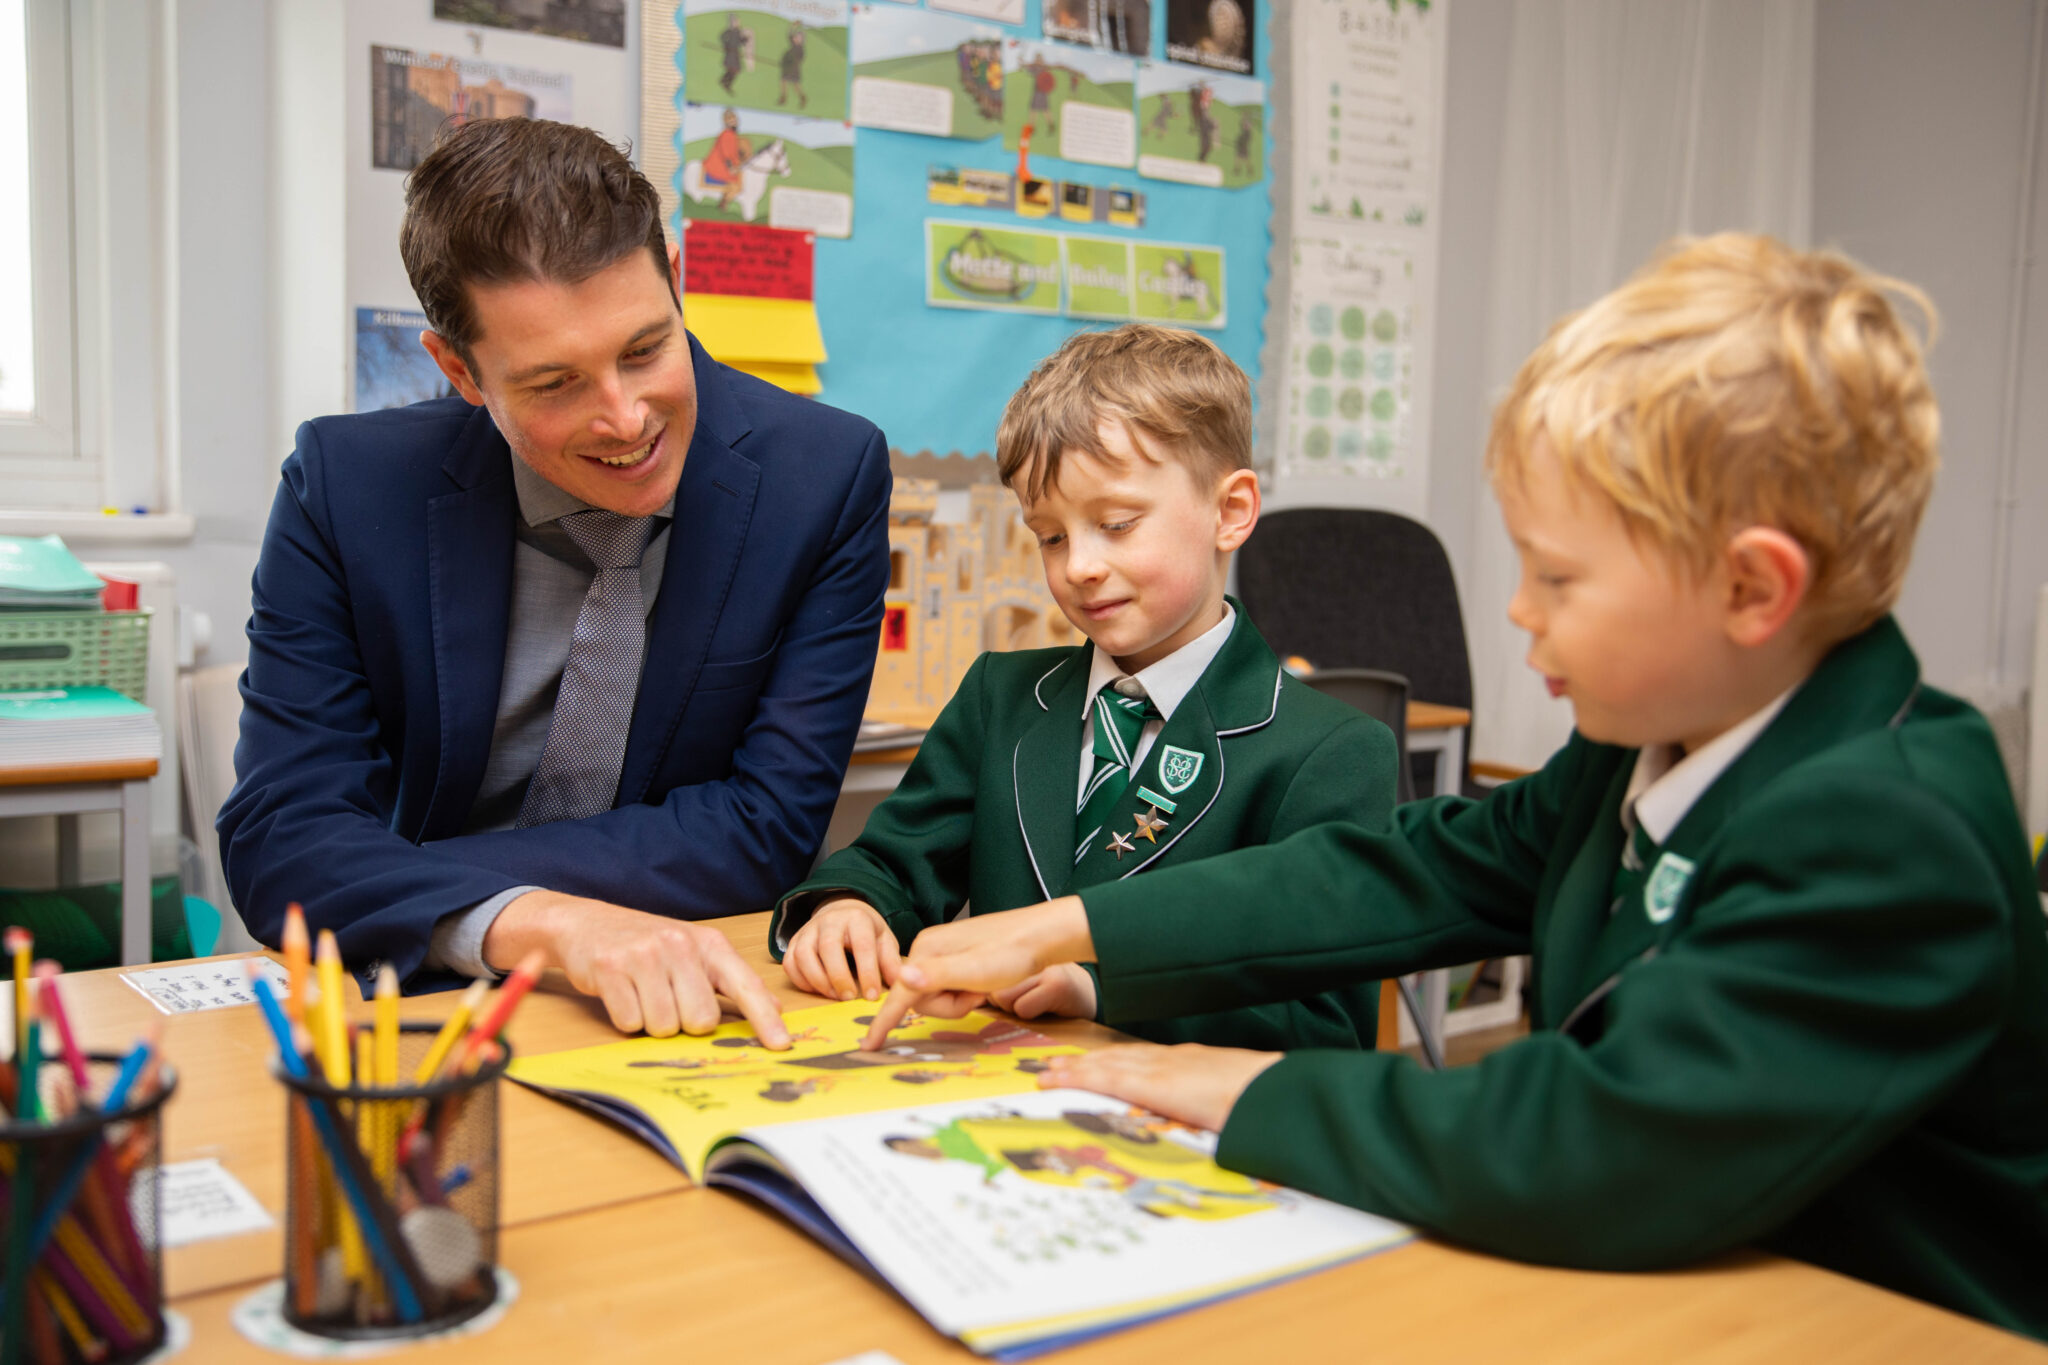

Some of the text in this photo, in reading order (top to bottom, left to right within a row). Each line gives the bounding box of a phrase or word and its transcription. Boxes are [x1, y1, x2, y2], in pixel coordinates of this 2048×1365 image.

[382, 49, 448, 70] Windsor
[507, 67, 564, 89] England
[950, 250, 1015, 280] Motte
[1018, 262, 1057, 283] and
[1070, 264, 1128, 297] Bailey
